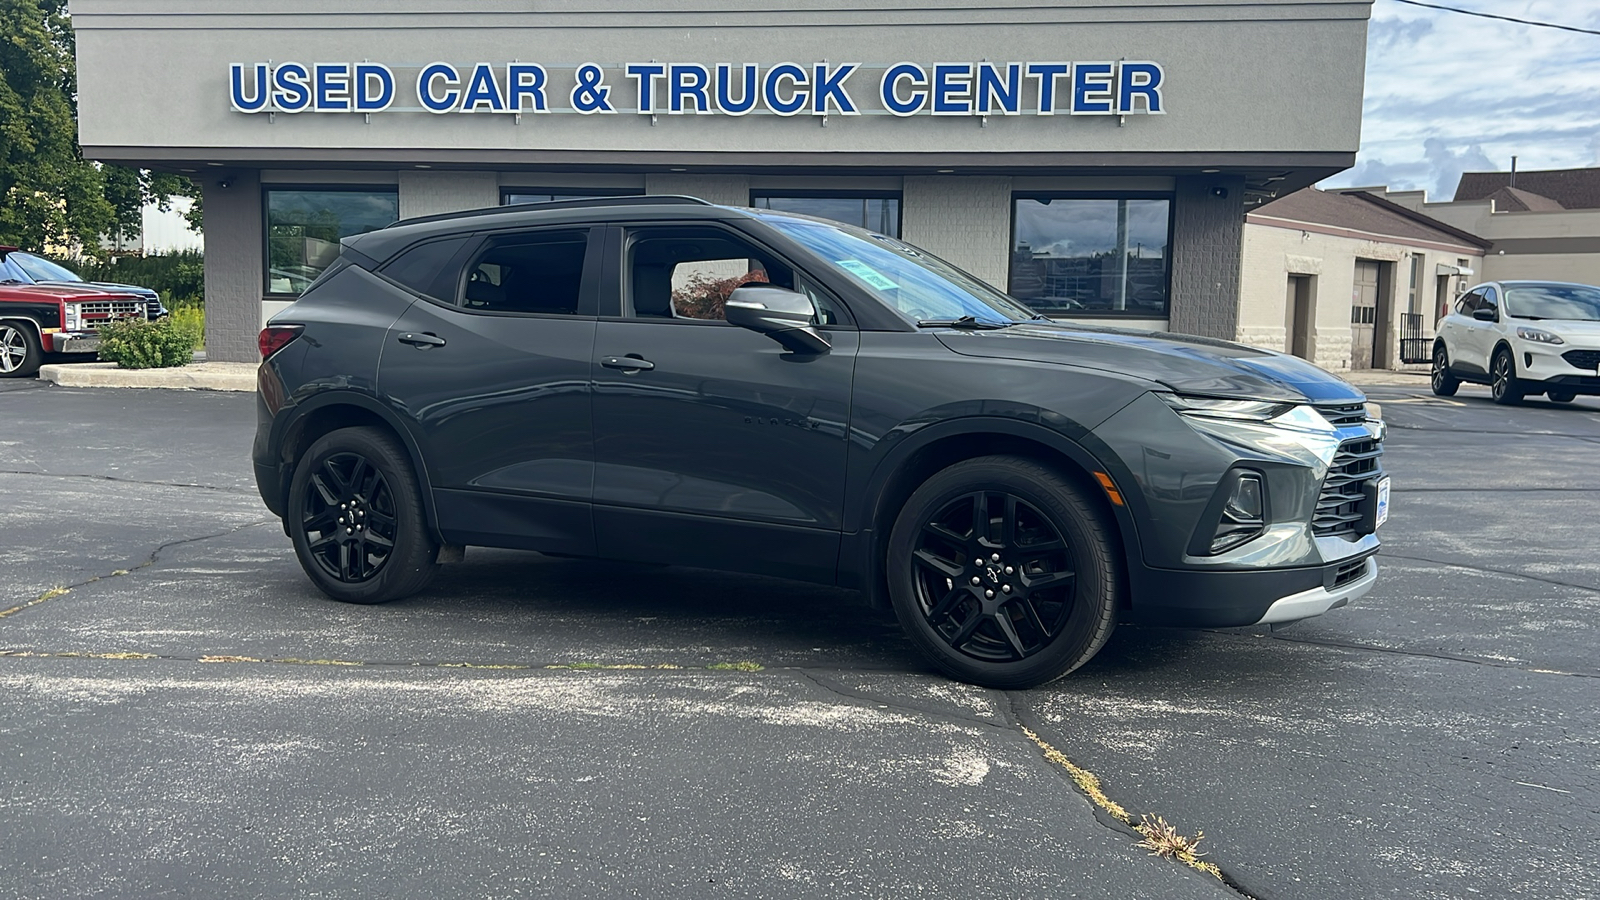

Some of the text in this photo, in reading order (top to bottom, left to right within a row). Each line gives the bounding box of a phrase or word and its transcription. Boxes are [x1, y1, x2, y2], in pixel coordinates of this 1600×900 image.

[229, 60, 1167, 116] USED CAR & TRUCK CENTER
